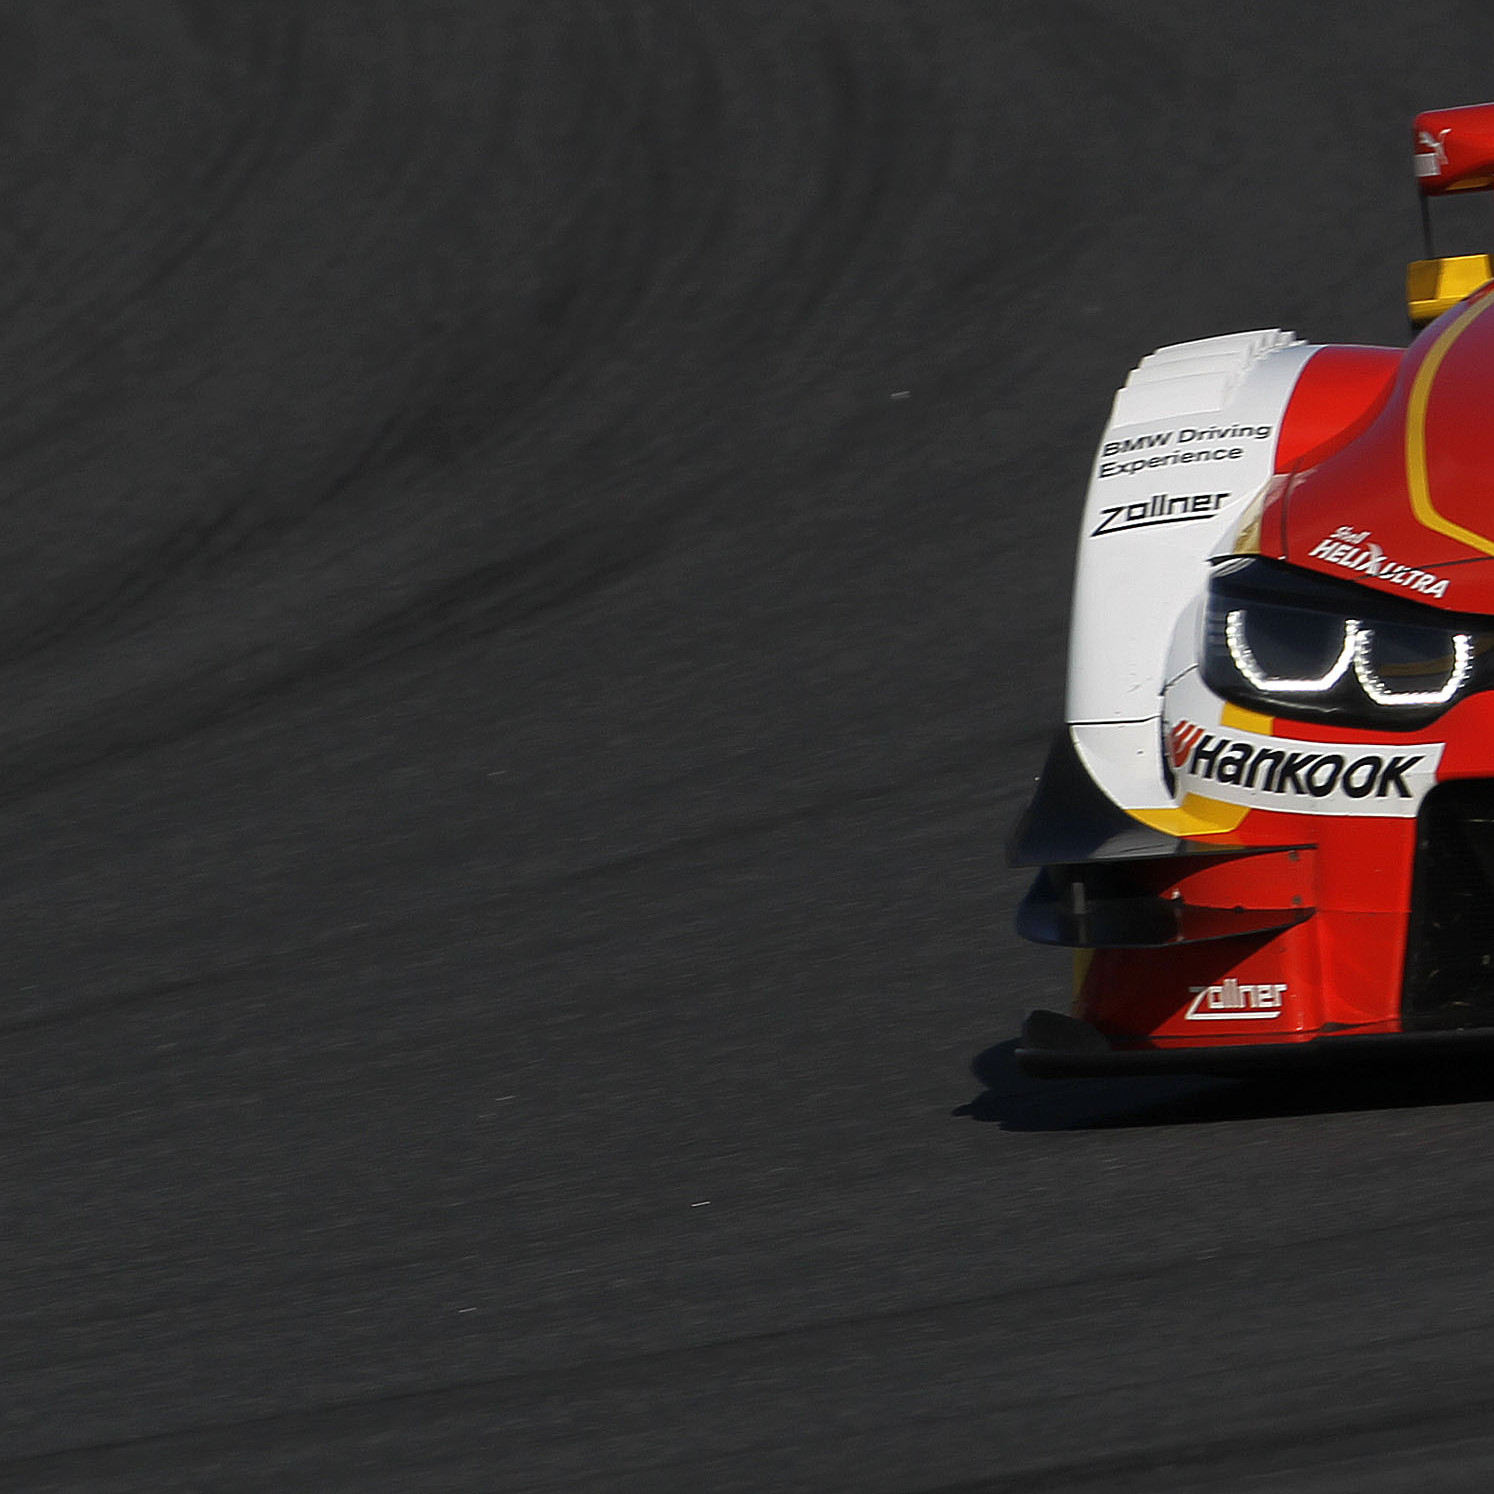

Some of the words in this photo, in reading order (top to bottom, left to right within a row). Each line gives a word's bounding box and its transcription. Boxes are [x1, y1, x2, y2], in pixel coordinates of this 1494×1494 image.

[1102, 432, 1173, 458] BMW
[1176, 423, 1275, 446] Driving
[1099, 444, 1245, 479] Experience
[1308, 538, 1385, 578] HELIX
[1379, 562, 1452, 599] ULTRA
